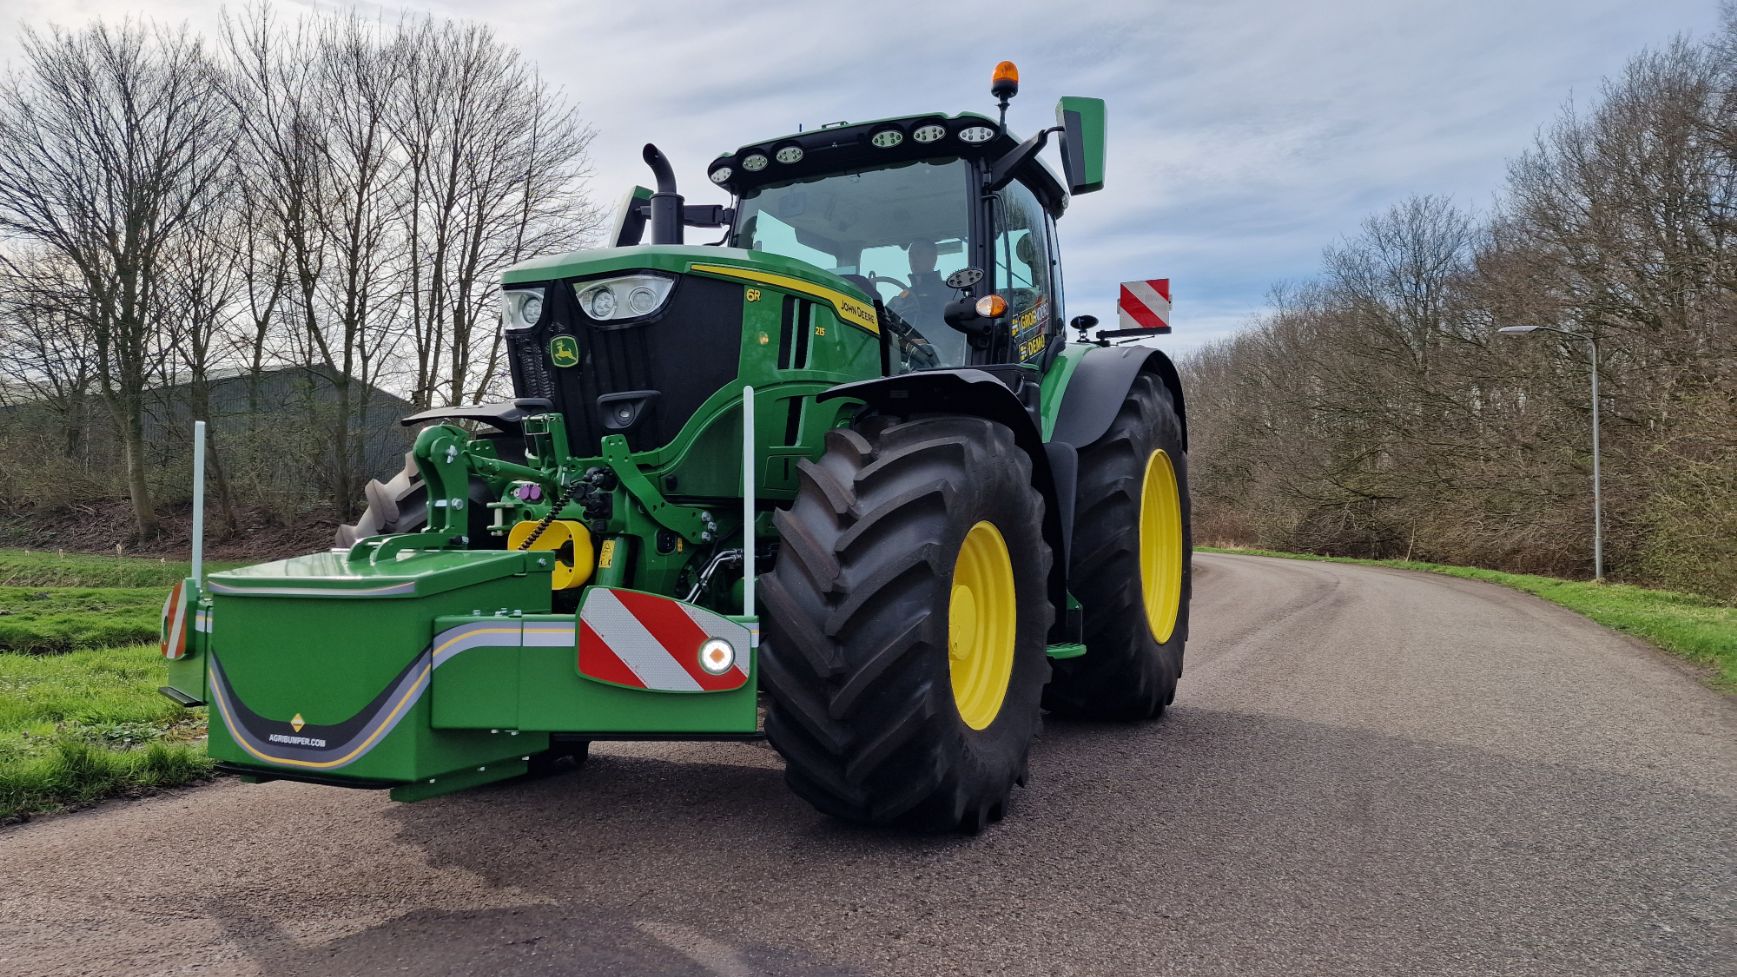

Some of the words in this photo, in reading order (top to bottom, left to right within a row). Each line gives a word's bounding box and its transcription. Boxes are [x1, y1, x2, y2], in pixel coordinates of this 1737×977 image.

[746, 288, 761, 302] 6R
[841, 300, 857, 314] JOHN
[856, 306, 875, 324] DEERE
[1028, 334, 1045, 356] DEMO
[269, 734, 326, 747] AGRIBUMPER.COM
